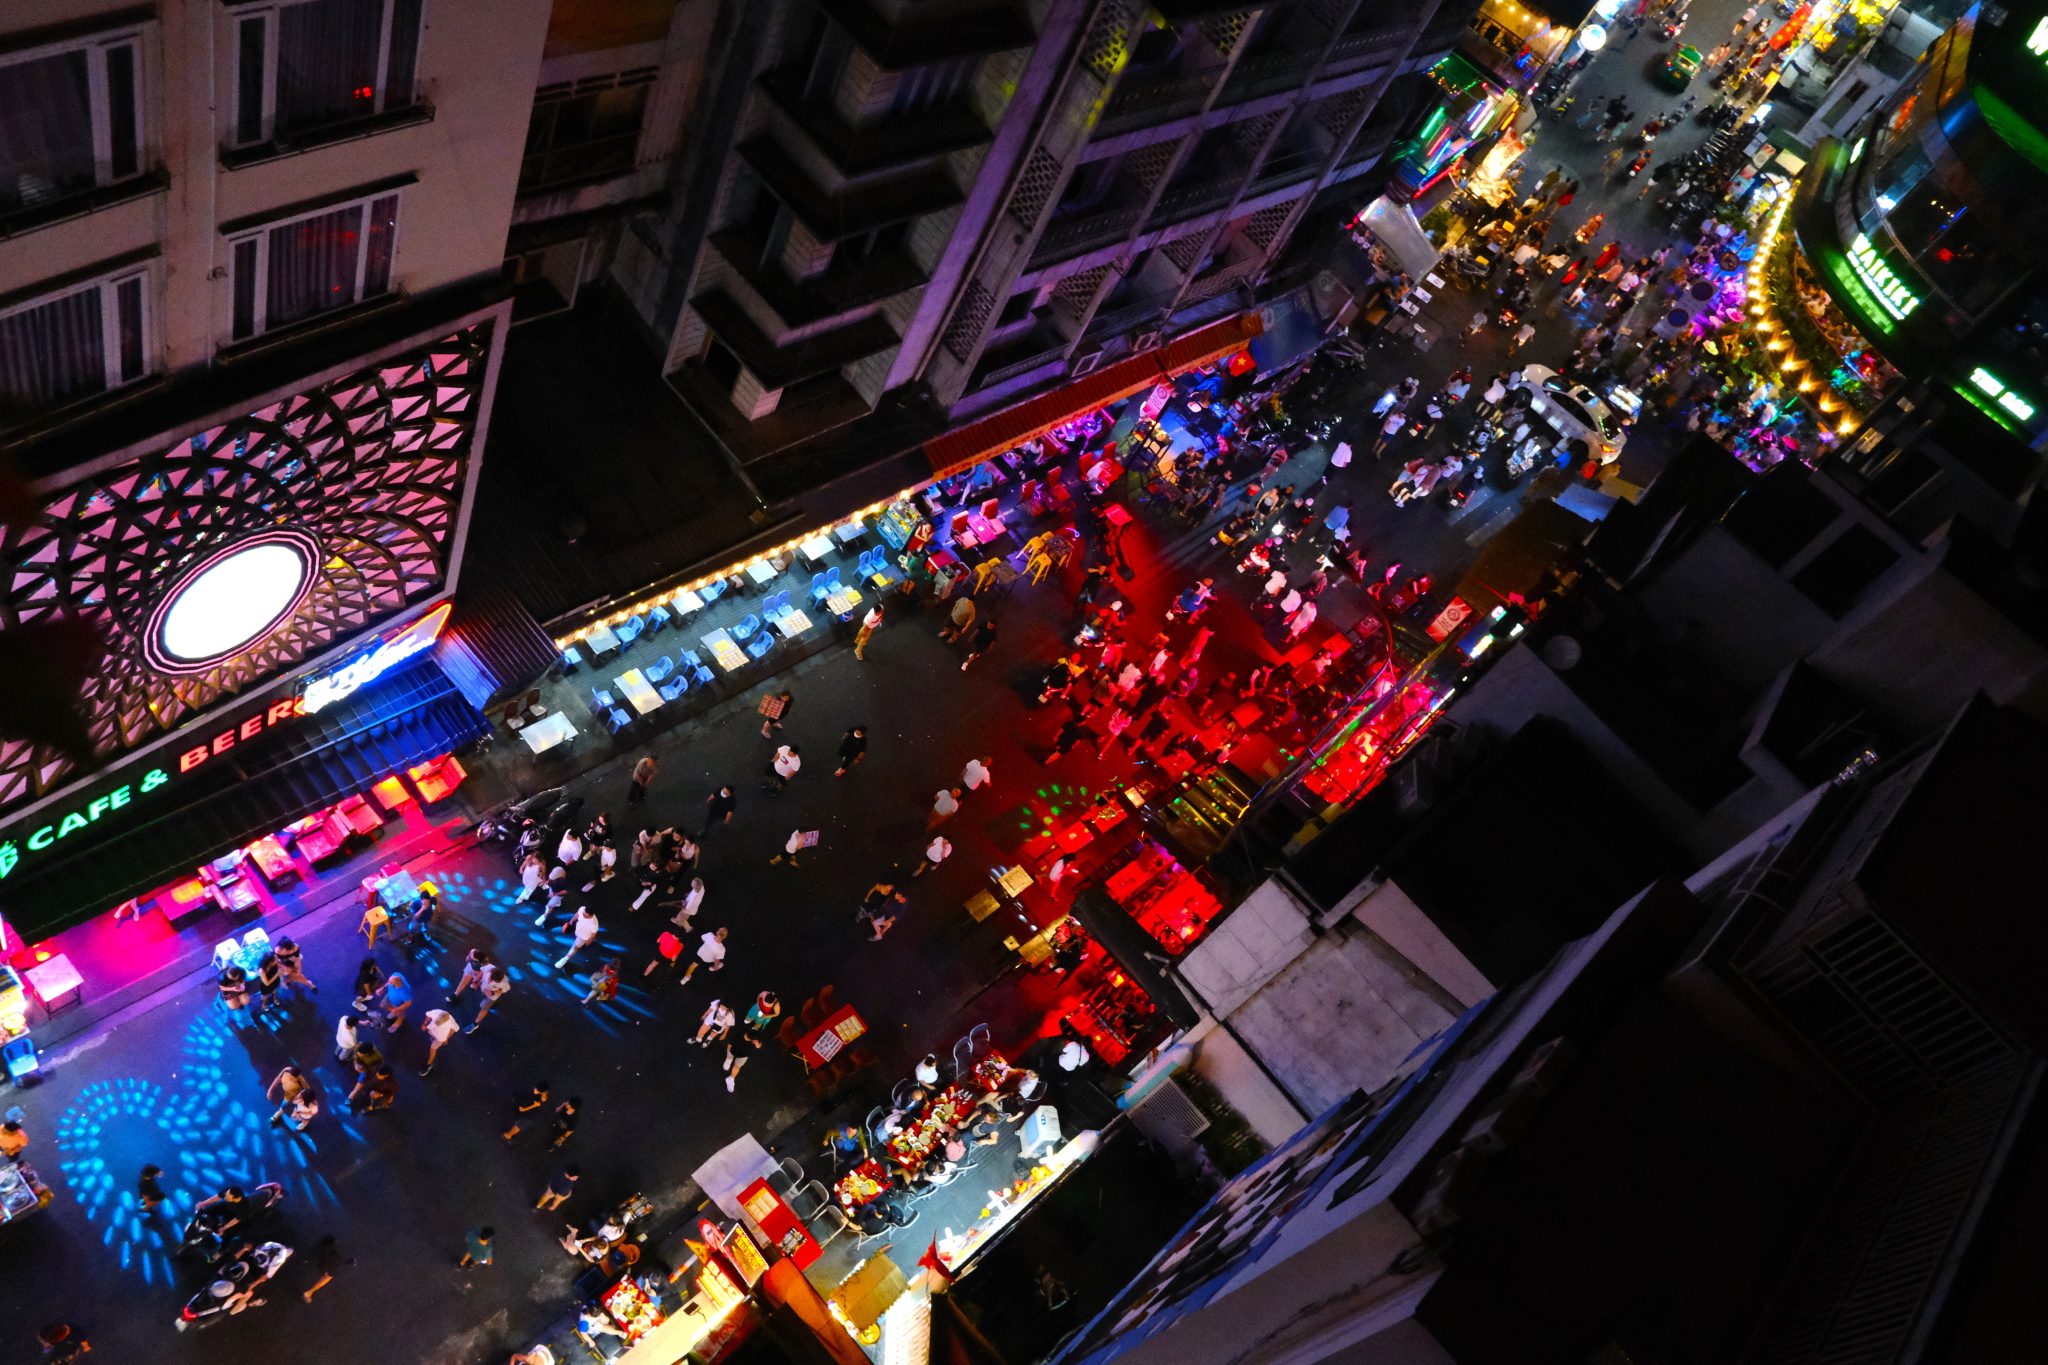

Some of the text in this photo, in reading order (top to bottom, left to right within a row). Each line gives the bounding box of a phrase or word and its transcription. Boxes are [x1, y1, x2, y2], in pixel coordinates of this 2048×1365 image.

[1851, 232, 1920, 316] WAIKIKI
[28, 700, 298, 851] CAFE & BEER
